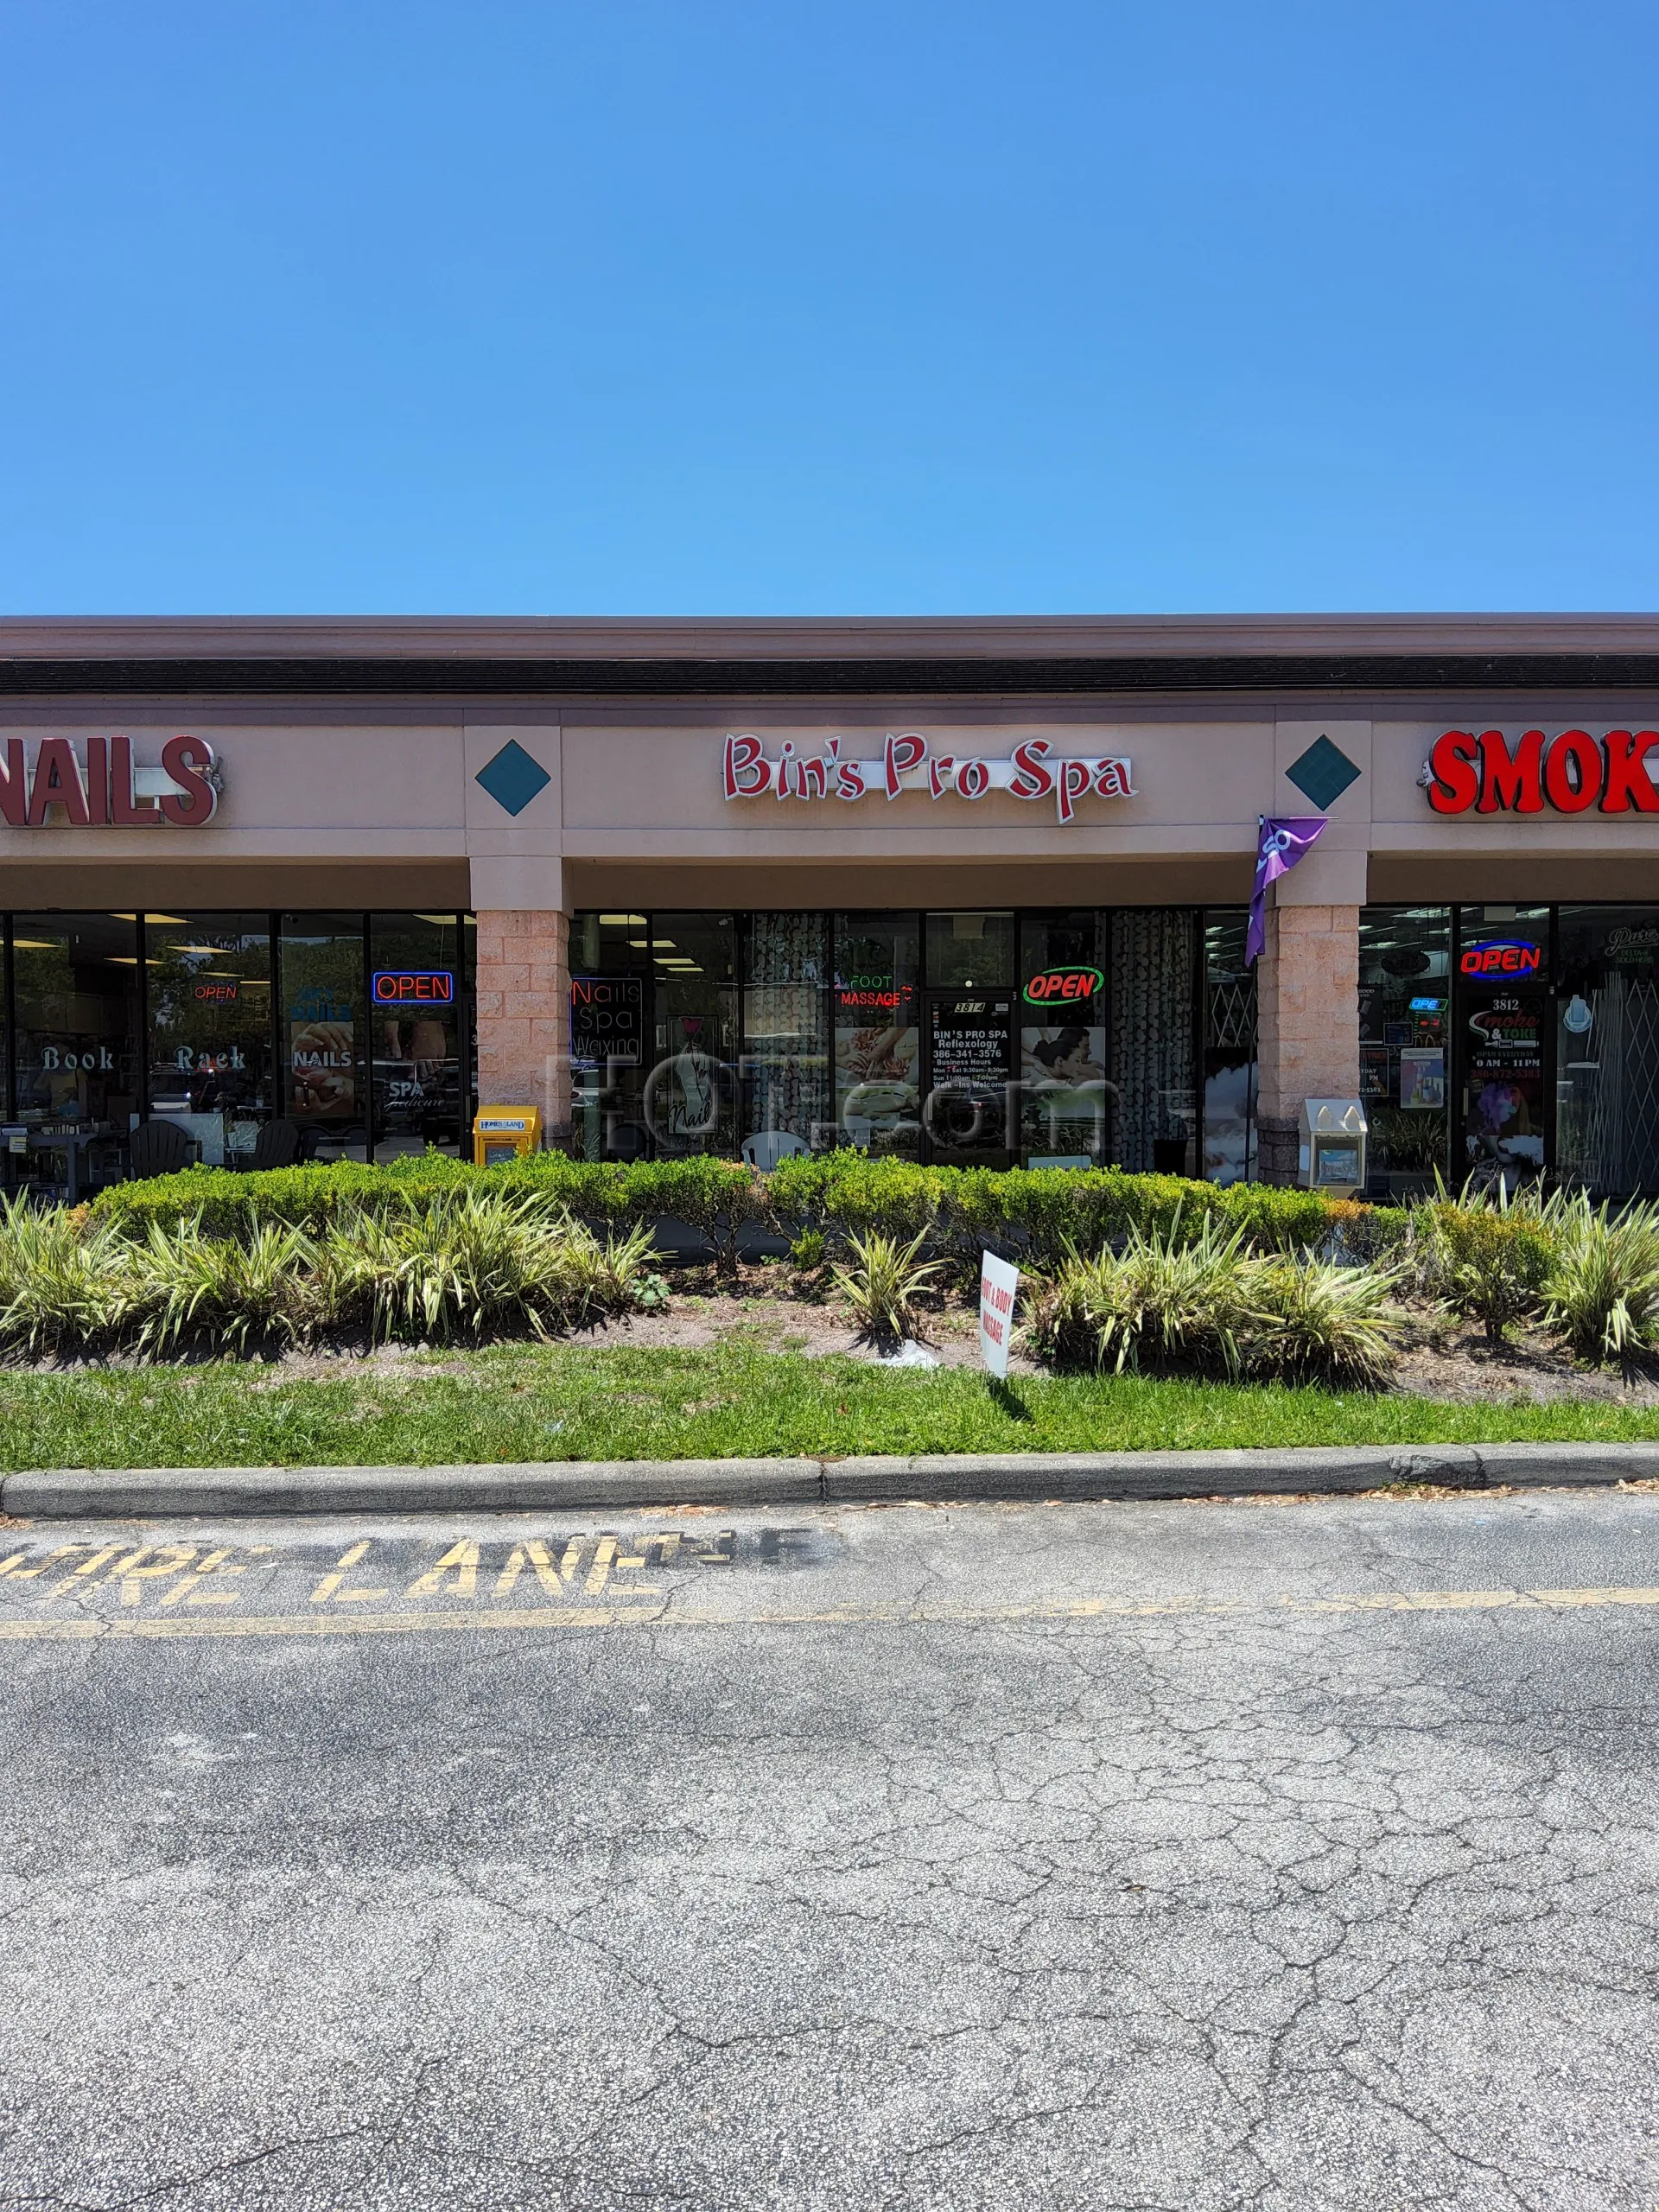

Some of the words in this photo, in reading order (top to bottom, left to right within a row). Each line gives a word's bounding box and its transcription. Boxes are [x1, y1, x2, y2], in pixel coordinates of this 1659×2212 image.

[0, 735, 216, 825] NAILS
[723, 733, 867, 801] Bin's
[884, 732, 991, 801] Pro
[1005, 738, 1139, 824] Spa
[1427, 729, 1659, 814] SMOK
[1459, 947, 1541, 974] OPEN
[194, 987, 237, 999] OPEN
[377, 975, 449, 999] OPEN
[573, 981, 639, 1006] Nails
[850, 976, 893, 989] FOOT
[1028, 974, 1096, 998] OPEN
[841, 992, 900, 1006] MASSAGE
[956, 1003, 985, 1012] 3814
[1492, 999, 1520, 1011] 3812
[579, 1007, 632, 1033] Spa
[938, 1039, 998, 1049] Reflexology
[965, 1030, 986, 1039] PRO
[988, 1030, 1008, 1039] SPA
[1491, 1028, 1502, 1039] &
[1503, 1027, 1536, 1039] TOKE
[41, 1046, 115, 1070] Book
[293, 1051, 352, 1067] NAILS
[572, 1035, 639, 1062] Waxing
[933, 1049, 1002, 1058] 386-341-3576
[389, 1081, 425, 1097] SPA
[480, 1121, 502, 1129] HOMES
[506, 1121, 524, 1129] LAND
[982, 1275, 993, 1302] FOOT
[995, 1287, 1013, 1316] BODY
[982, 1308, 1004, 1346] MASSAGE
[308, 1532, 665, 1604] LANE
